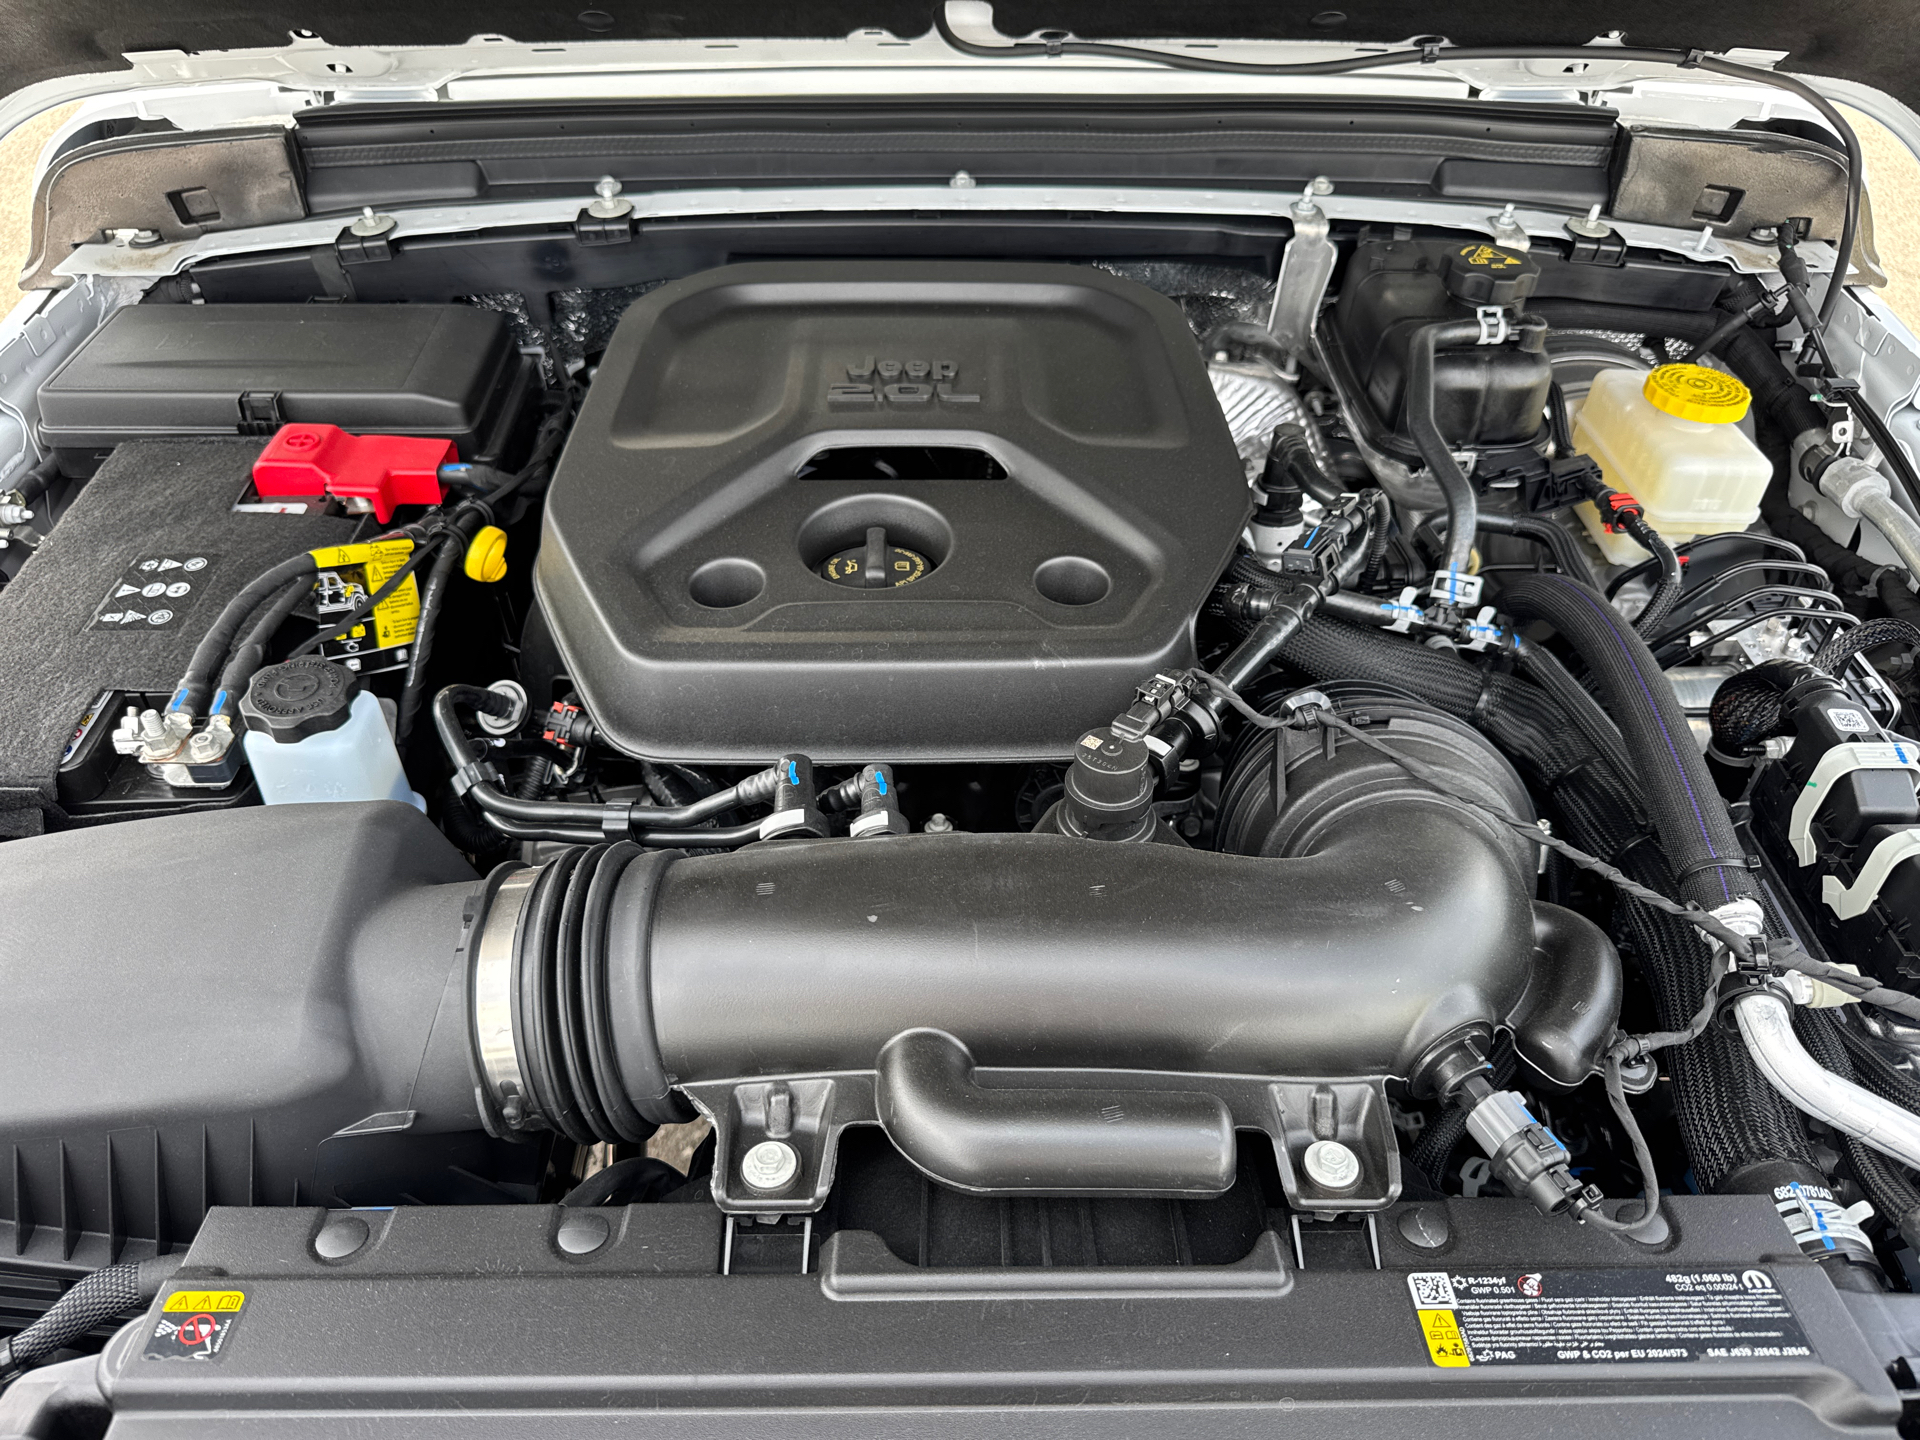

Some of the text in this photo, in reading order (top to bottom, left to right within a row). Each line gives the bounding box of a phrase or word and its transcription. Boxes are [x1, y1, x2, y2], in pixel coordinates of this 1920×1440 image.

[847, 356, 959, 383] Jeep
[827, 383, 981, 403] 2.0L
[257, 698, 304, 715] APPROVED
[1773, 1184, 1834, 1201] 6820781AD
[1467, 1277, 1507, 1286] R-1234yf
[1674, 1283, 1694, 1291] CO2
[1470, 1286, 1516, 1294] GWP 0.501
[1495, 1350, 1517, 1360] PAG
[1557, 1349, 1689, 1361] GWP & CO2 per EU 2024/573
[1706, 1347, 1729, 1358] SAE
